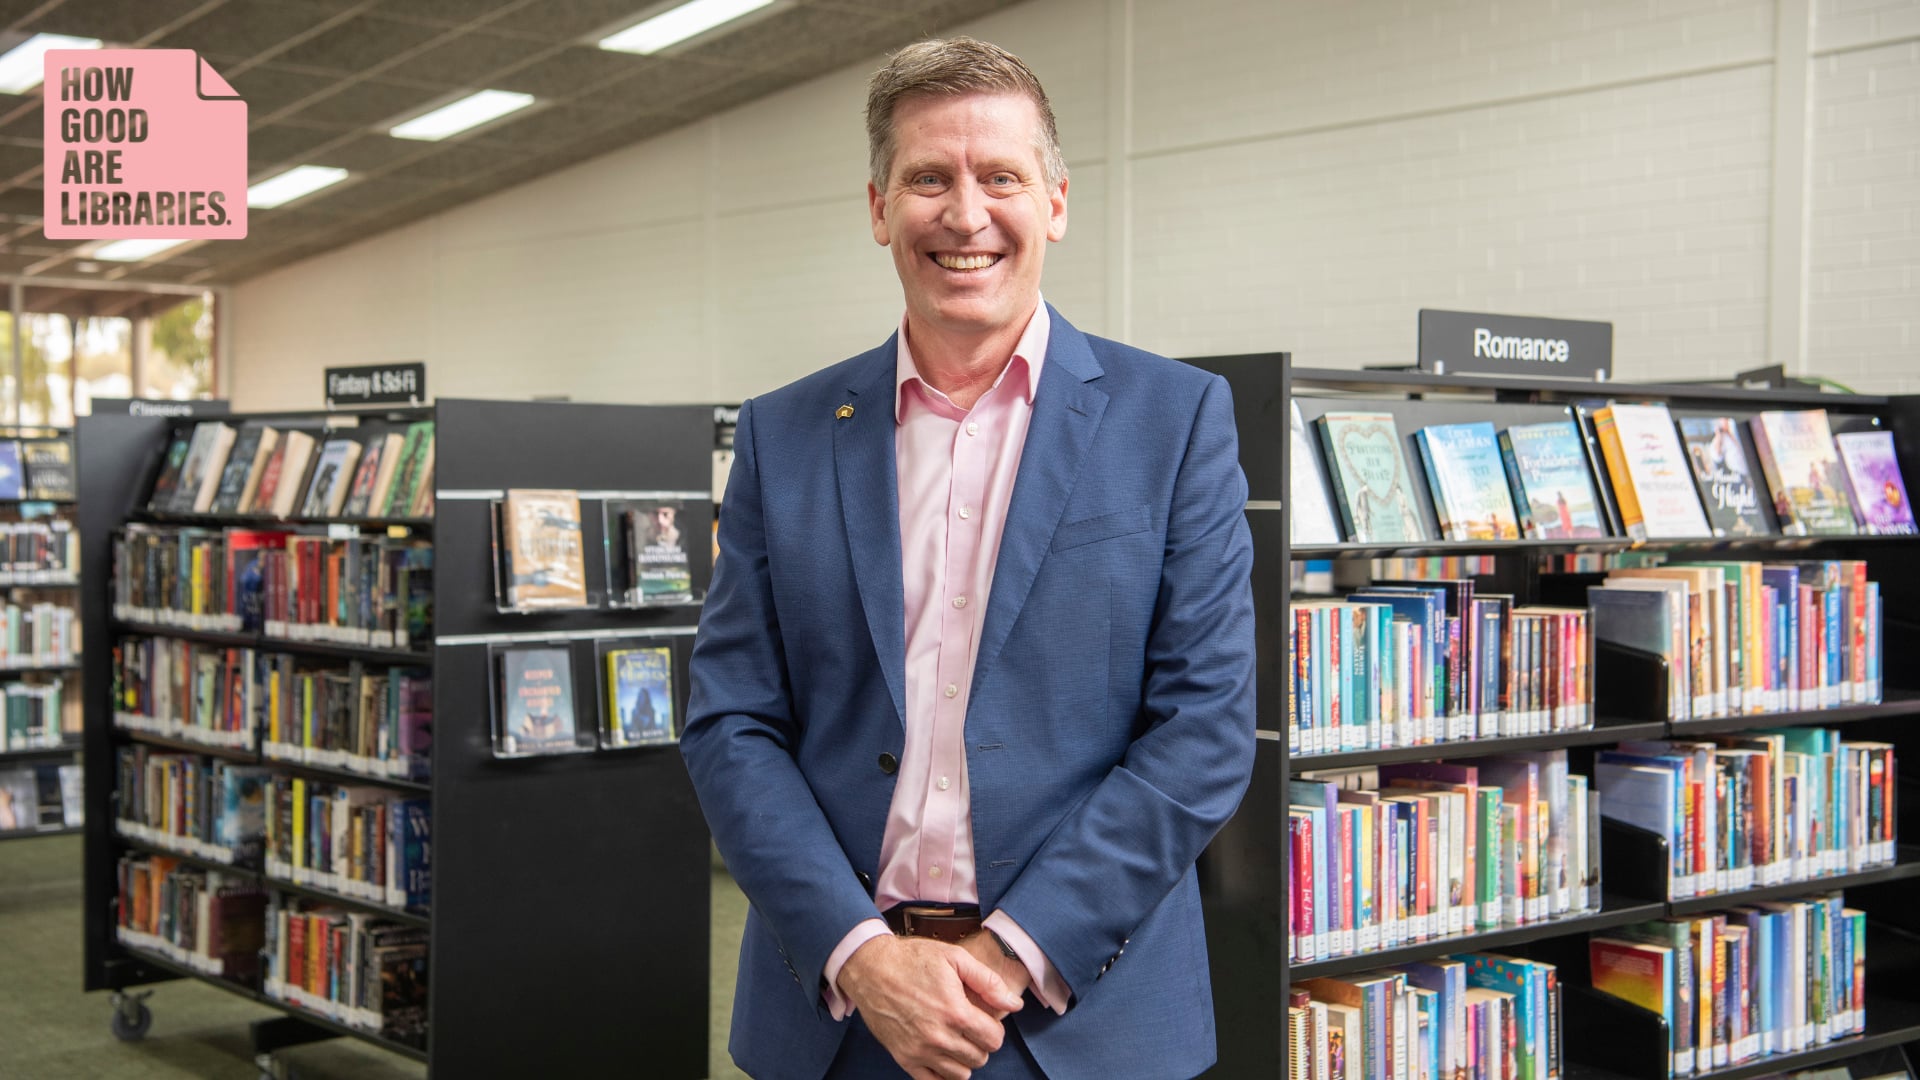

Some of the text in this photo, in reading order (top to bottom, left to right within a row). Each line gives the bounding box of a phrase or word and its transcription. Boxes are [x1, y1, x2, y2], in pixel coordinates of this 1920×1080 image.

[1474, 328, 1570, 362] Romance
[329, 373, 371, 399] Fantasy
[372, 371, 382, 394] &
